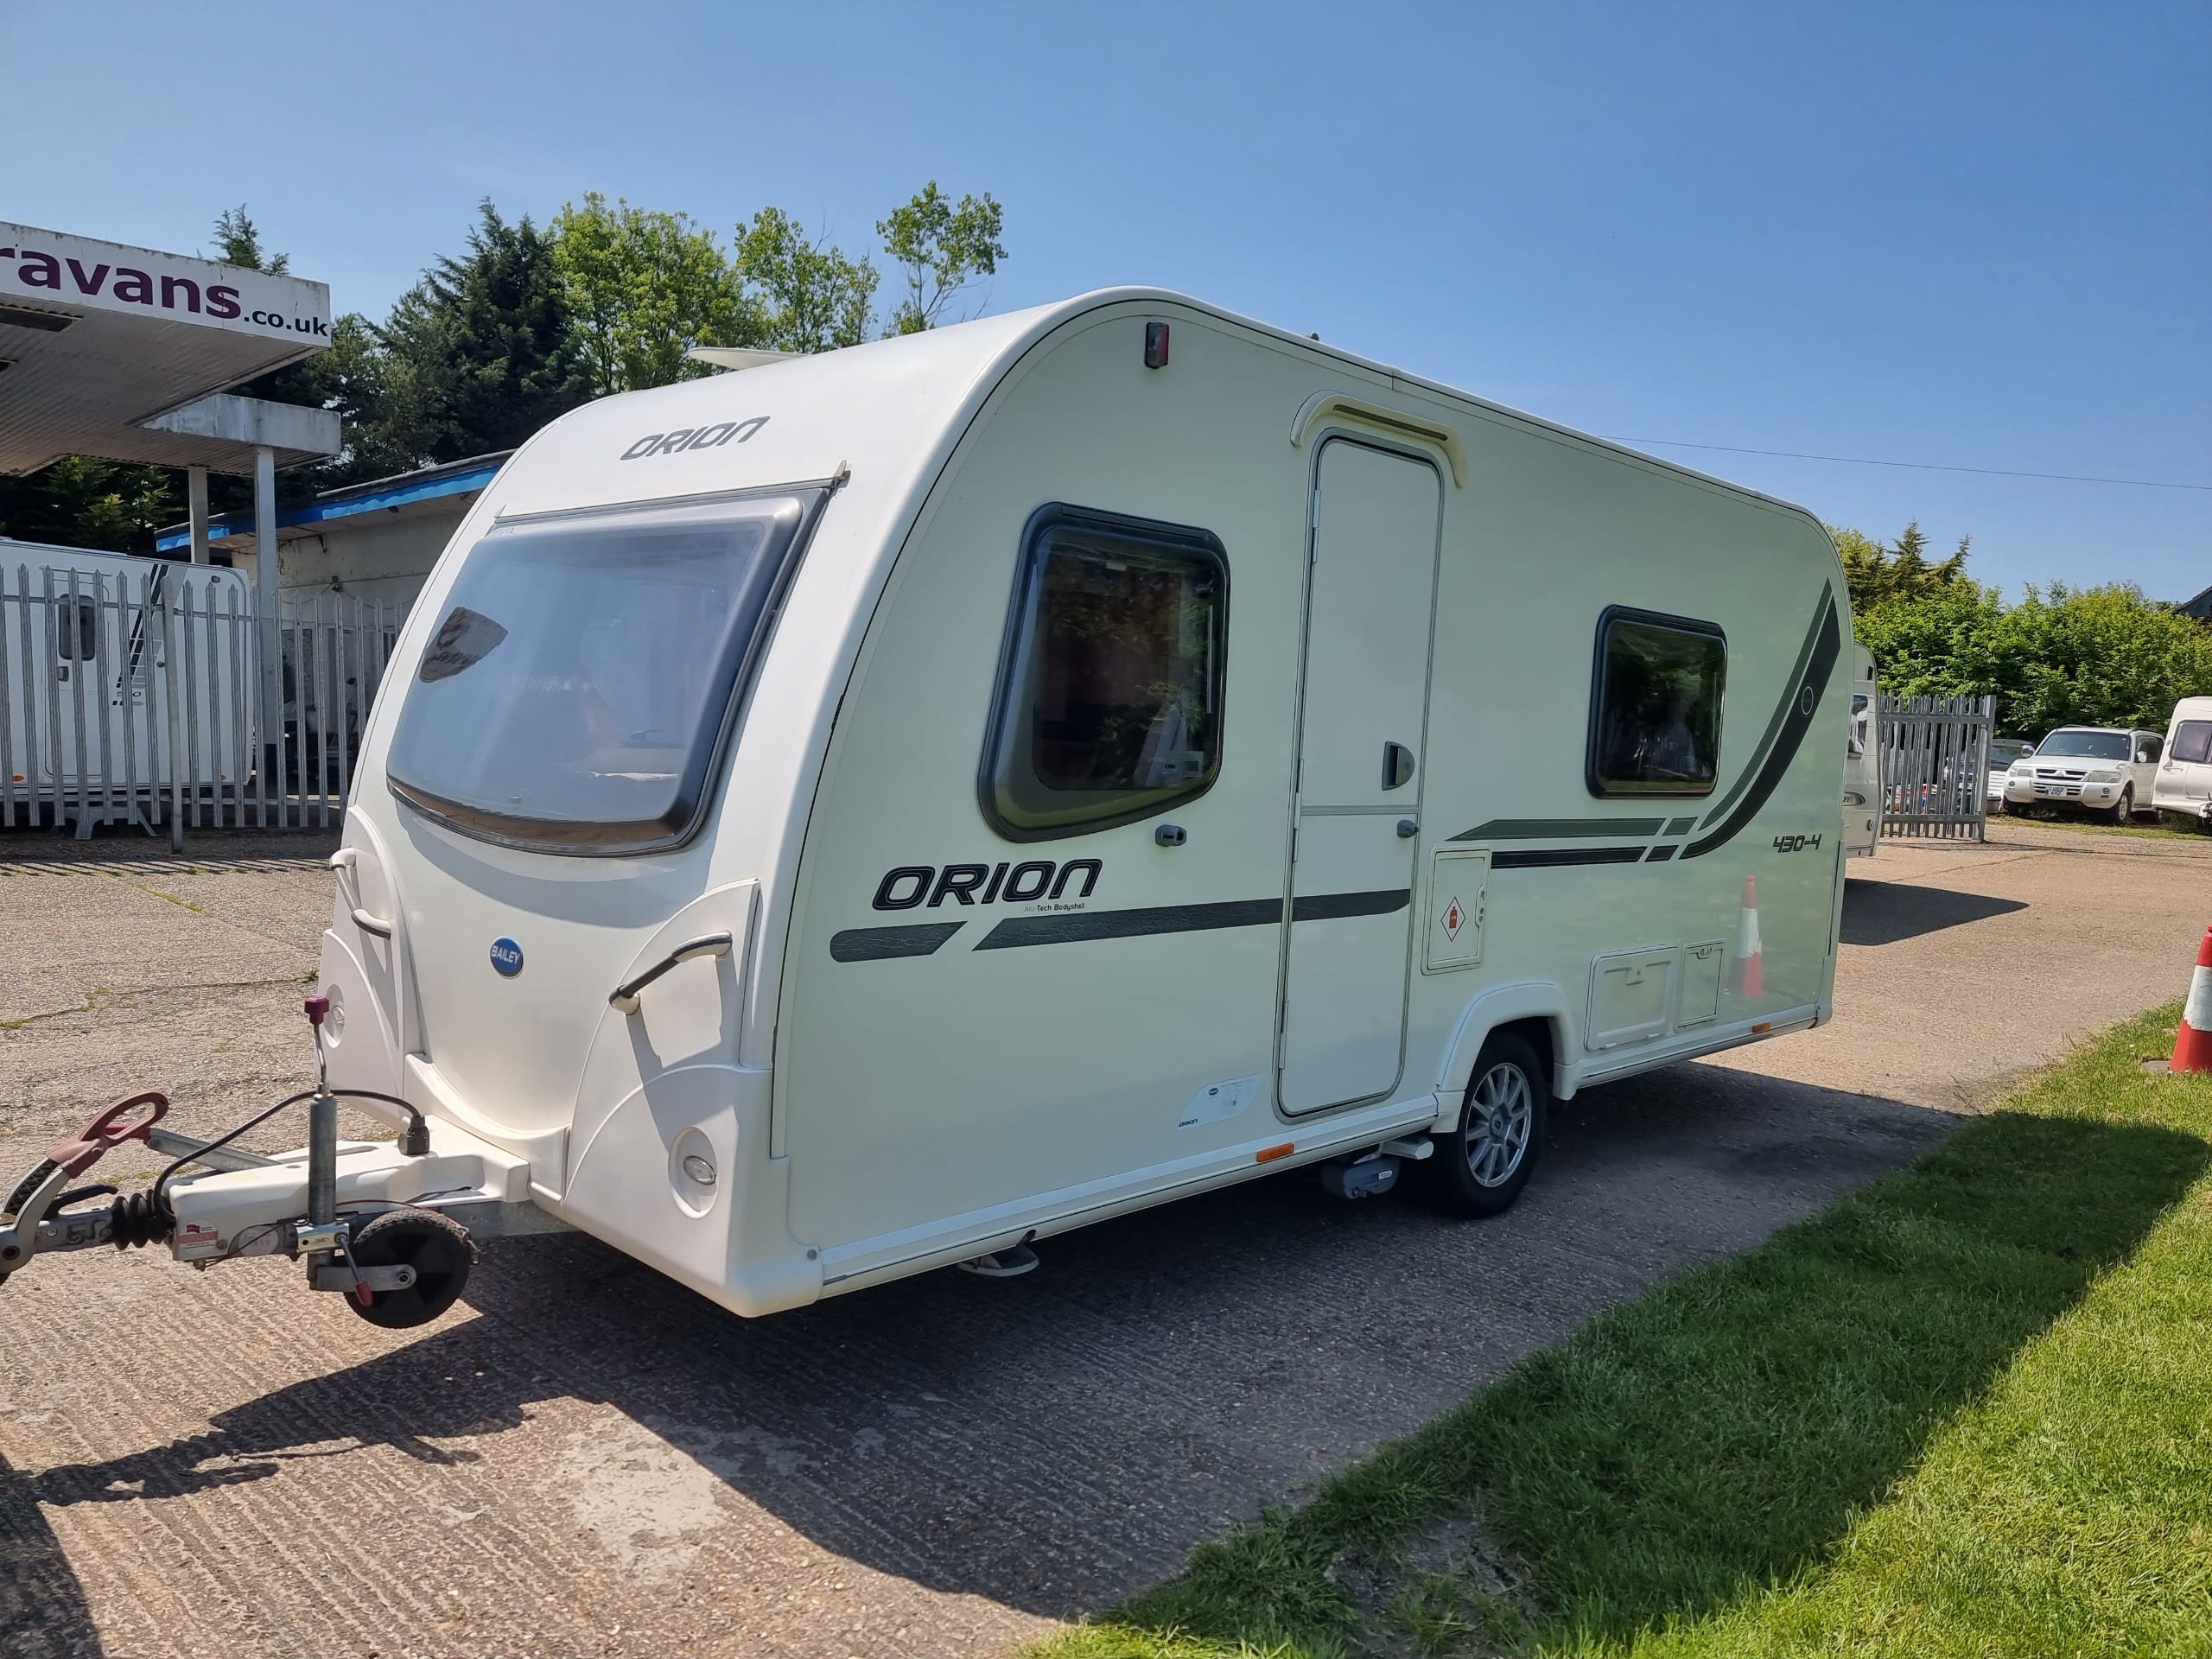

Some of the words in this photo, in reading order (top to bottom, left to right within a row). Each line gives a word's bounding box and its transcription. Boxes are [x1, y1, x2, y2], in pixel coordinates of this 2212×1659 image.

[620, 416, 771, 461] ORION
[1772, 834, 1822, 853] 430-4
[872, 858, 1103, 911] ORION
[1054, 902, 1085, 911] Bodyshell
[491, 945, 521, 965] BAILEY
